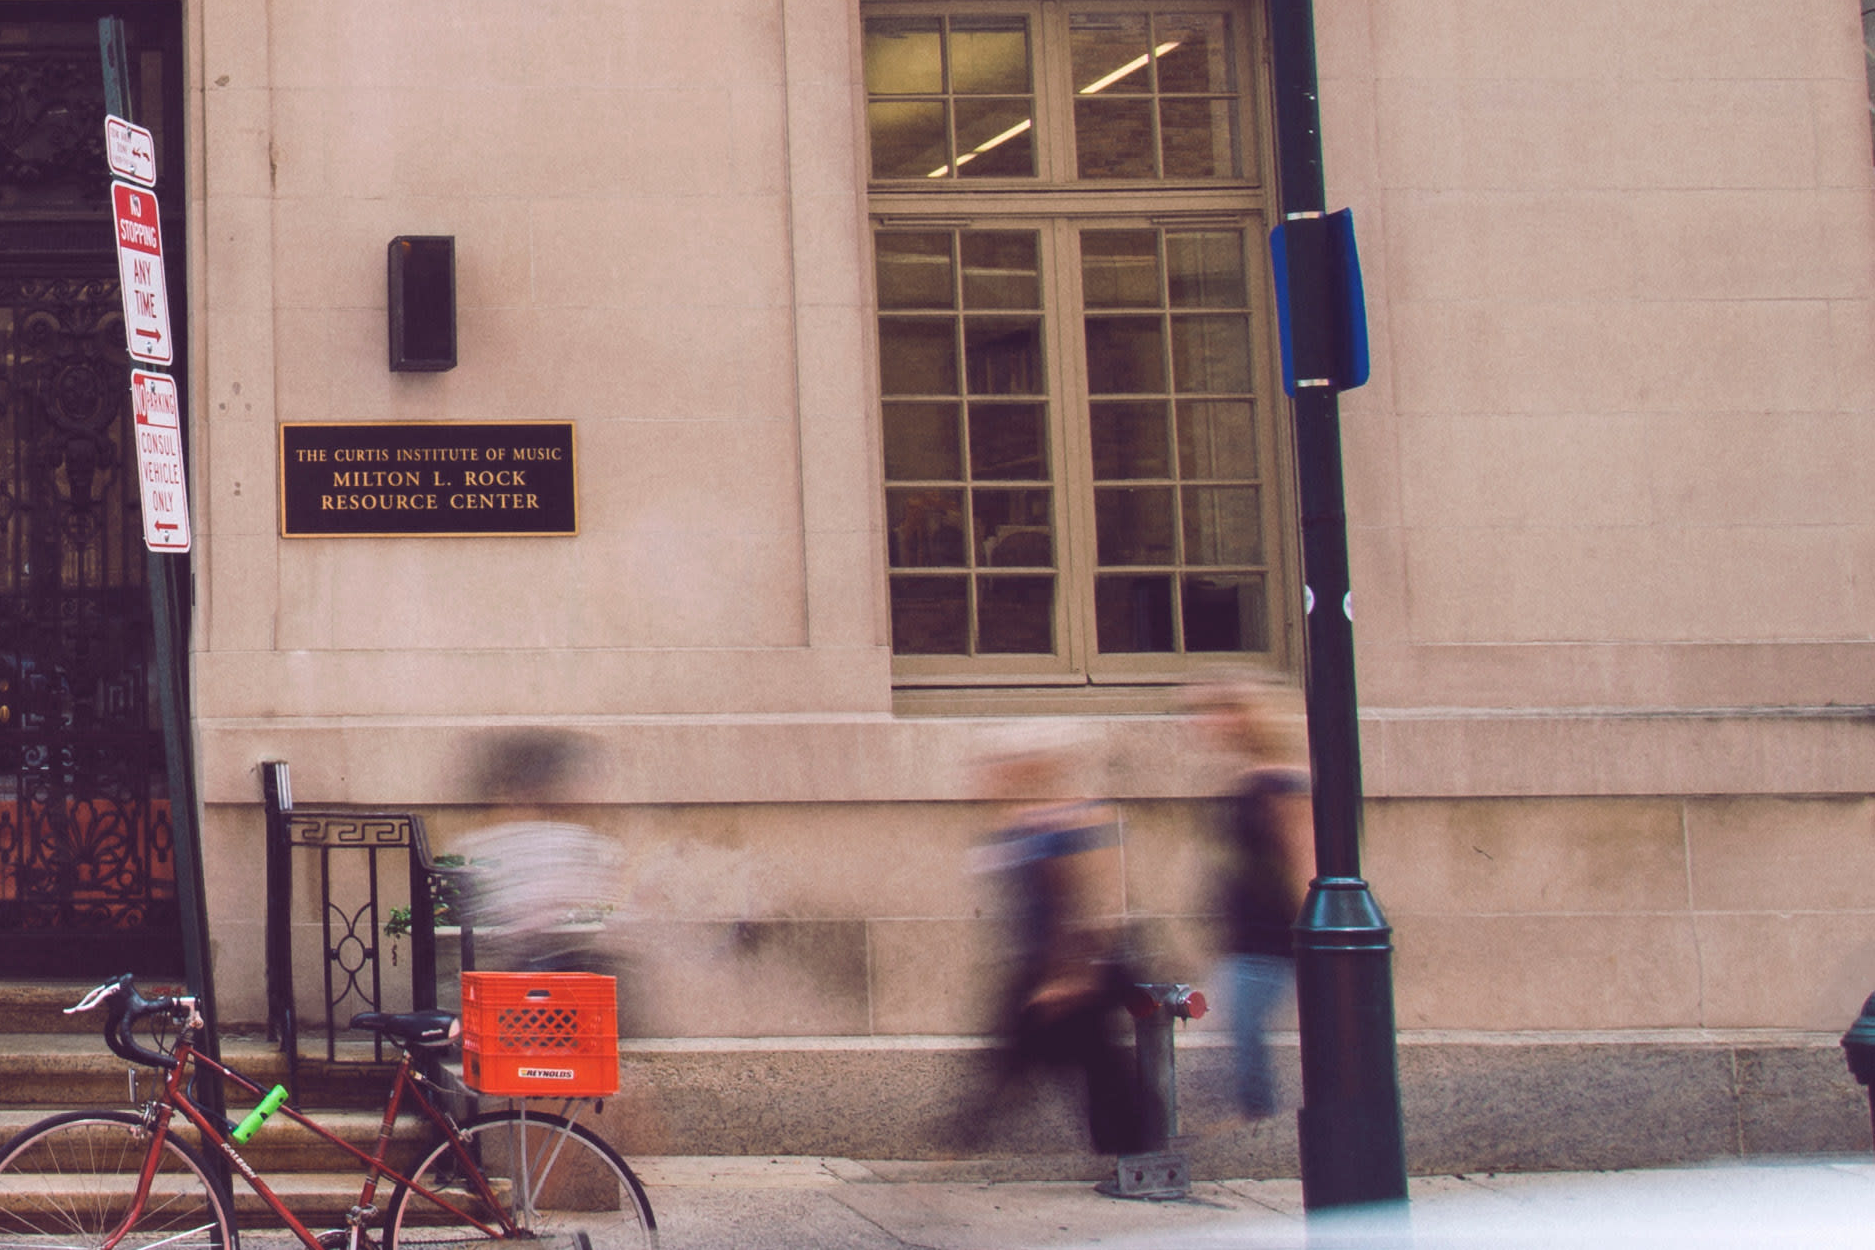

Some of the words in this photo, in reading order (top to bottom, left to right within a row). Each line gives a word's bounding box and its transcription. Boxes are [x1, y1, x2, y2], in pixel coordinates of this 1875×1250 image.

[129, 194, 142, 218] NO
[120, 218, 157, 249] STOPPING
[134, 258, 152, 287] ANY
[134, 290, 157, 319] TIME
[134, 382, 148, 417] NO
[145, 390, 175, 415] PARKING
[141, 432, 176, 456] CONSUL
[296, 448, 328, 462] THE
[334, 448, 390, 462] CURTIS
[396, 448, 479, 462] INSTITUTE
[485, 447, 507, 461] OF
[512, 447, 562, 461] MUSIC
[143, 461, 180, 485] VEHICLE
[333, 471, 422, 487] MILTON
[433, 471, 452, 487] L.
[465, 470, 527, 486] ROCK
[152, 490, 174, 512] ONLY
[321, 494, 438, 511] RESOURCE
[449, 493, 540, 509] CENTER
[526, 1069, 572, 1079] REYNOLDS
[221, 1142, 257, 1179] RALEIGH
